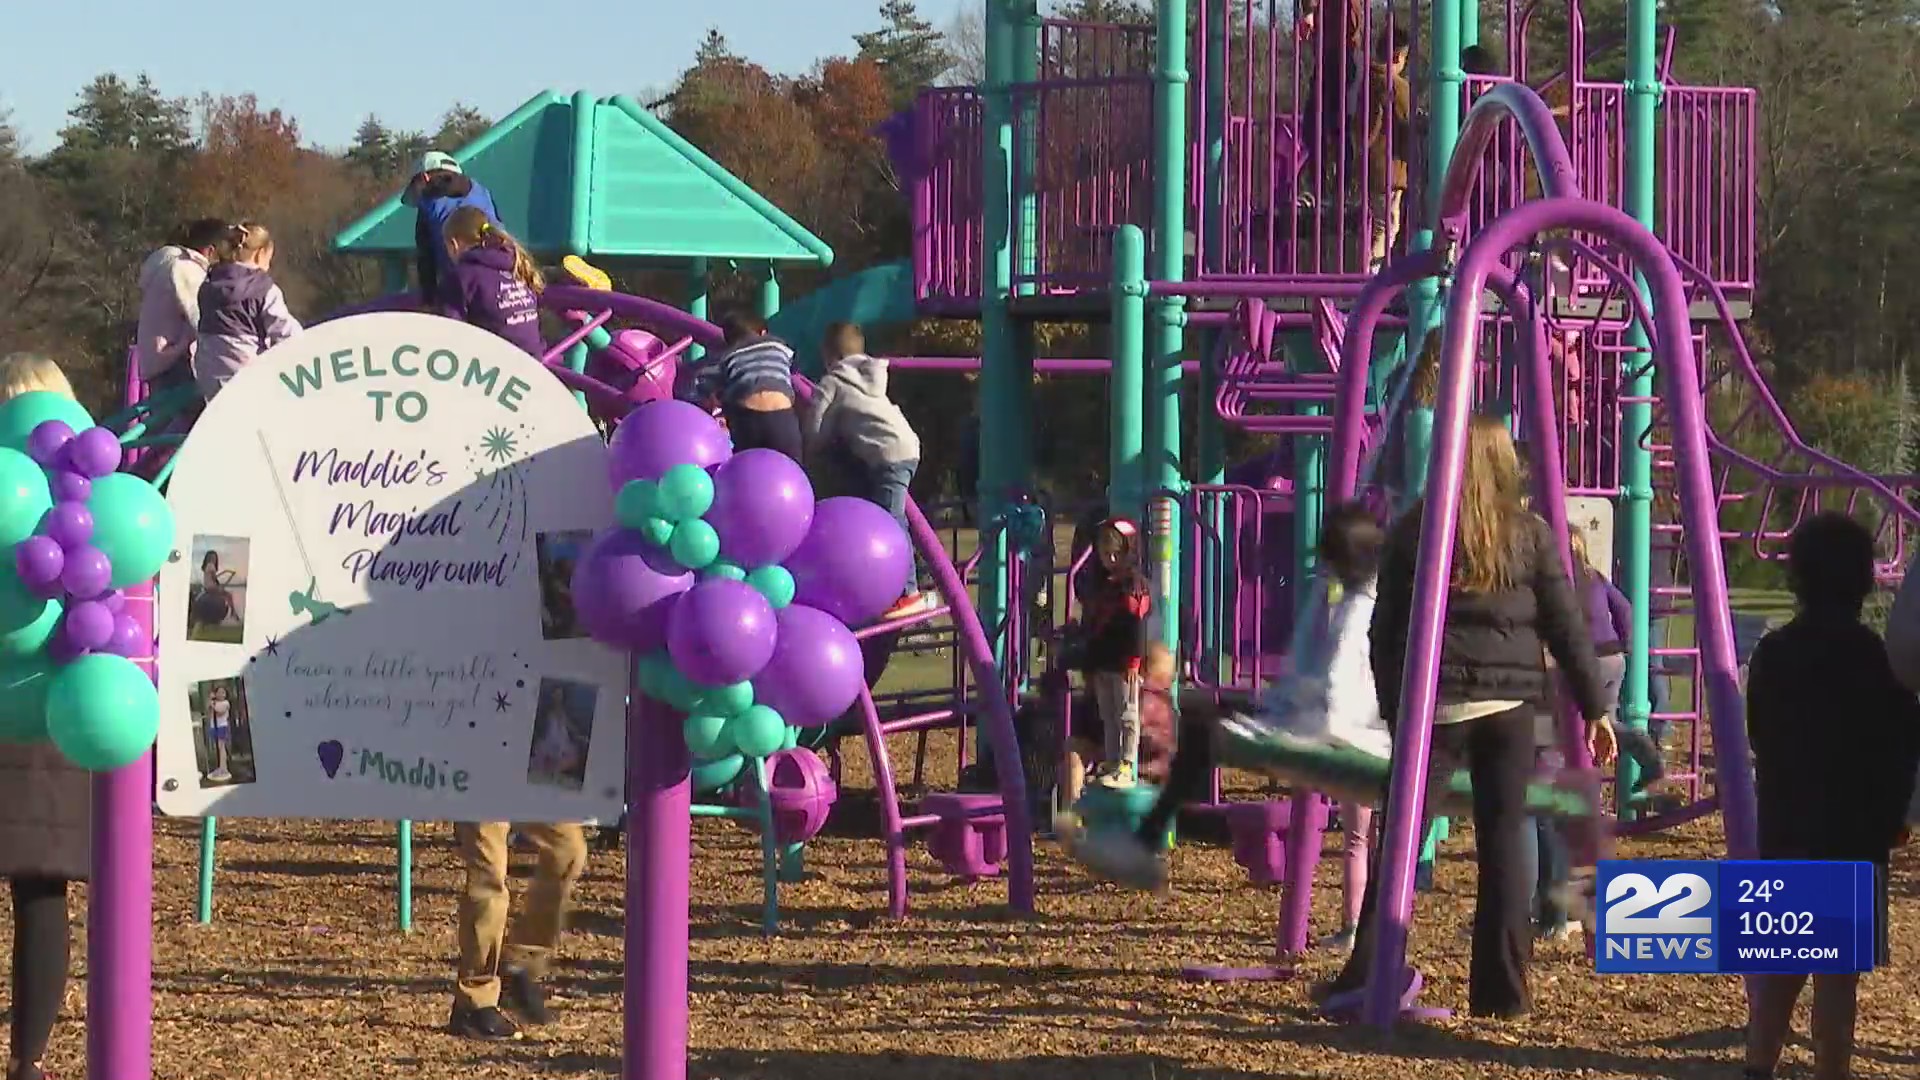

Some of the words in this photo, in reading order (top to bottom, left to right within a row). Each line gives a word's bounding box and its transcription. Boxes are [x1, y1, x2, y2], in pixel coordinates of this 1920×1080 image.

[279, 344, 531, 413] WELCOME
[366, 390, 428, 423] TO
[293, 447, 447, 489] Maddie's
[329, 500, 462, 545] Magical
[342, 548, 510, 590] Playground
[359, 748, 469, 792] Maddie
